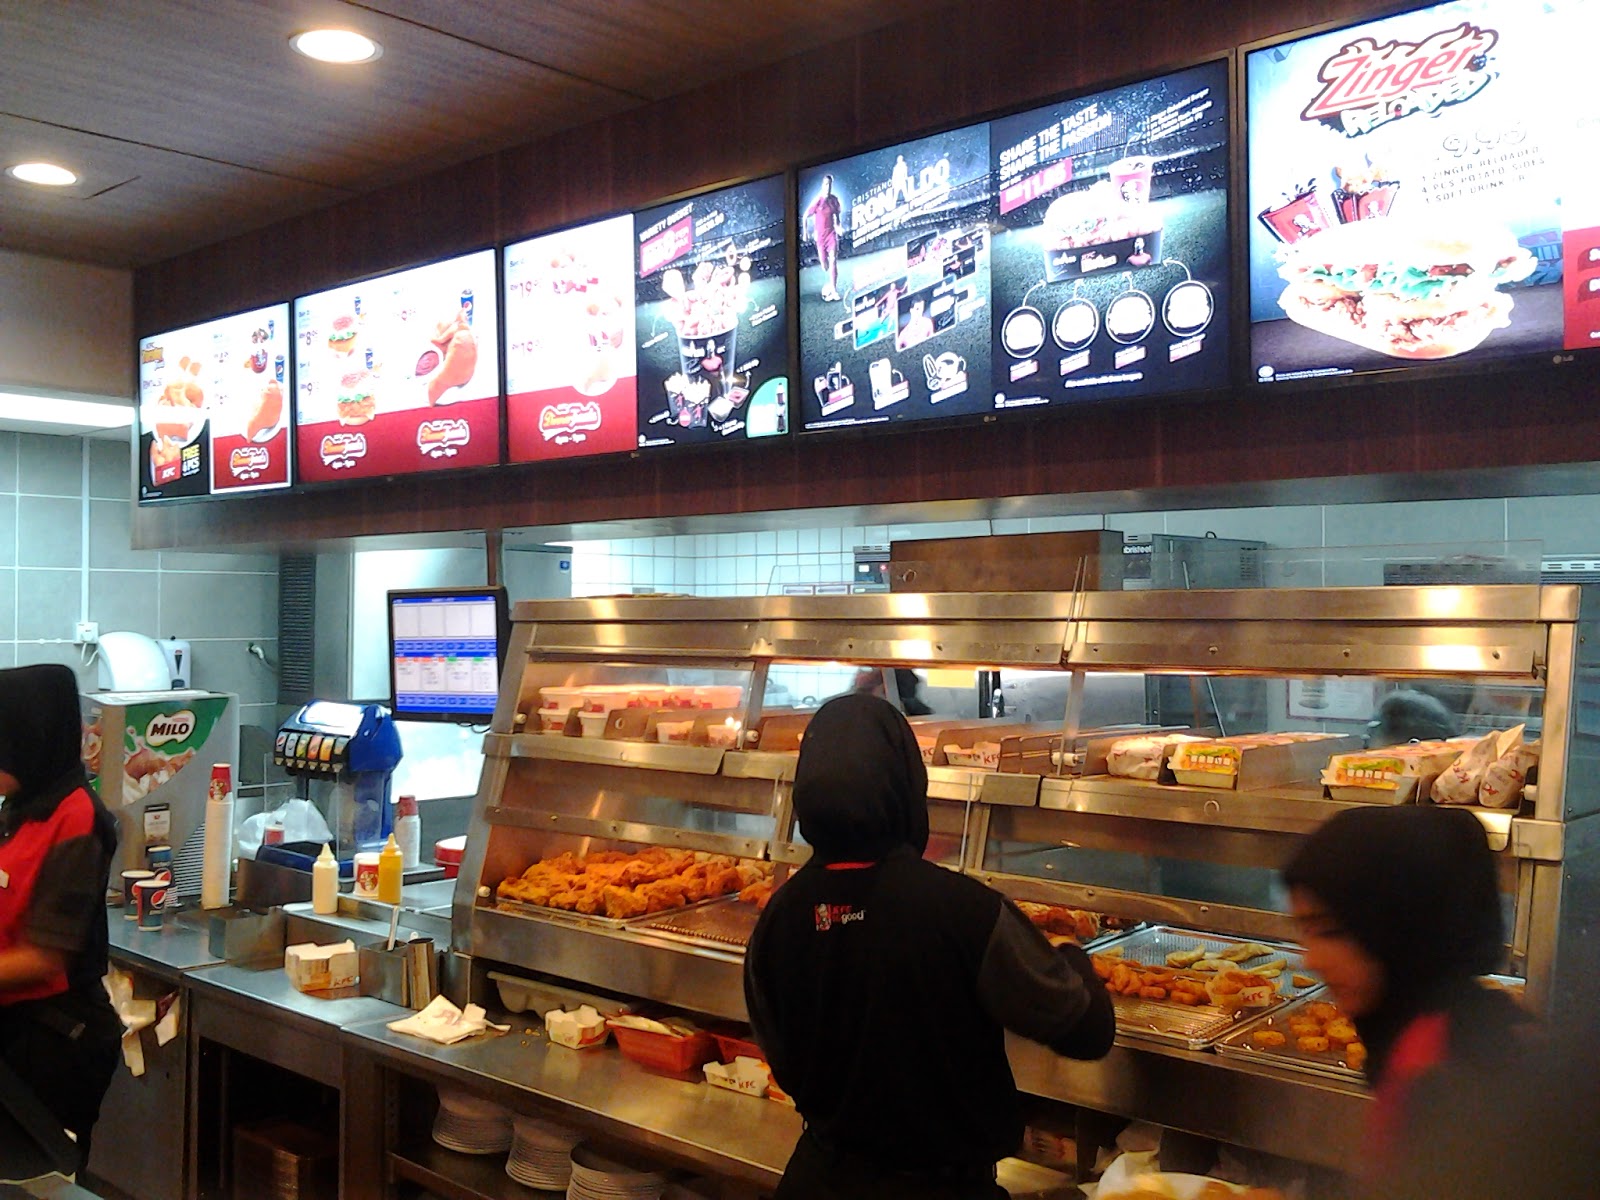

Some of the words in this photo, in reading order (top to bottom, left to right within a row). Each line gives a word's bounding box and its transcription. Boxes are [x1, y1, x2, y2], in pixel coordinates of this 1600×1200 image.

[1309, 40, 1485, 112] Zinger
[1340, 72, 1492, 139] RELOADED
[999, 134, 1038, 168] SHARE
[1037, 121, 1061, 147] THE
[1061, 101, 1099, 131] TASTE
[999, 149, 1038, 181] SHARE
[1469, 179, 1505, 195] DRINK
[182, 443, 200, 461] FREE
[150, 722, 190, 737] MILO
[841, 909, 865, 925] good
[738, 1079, 757, 1090] KFC
